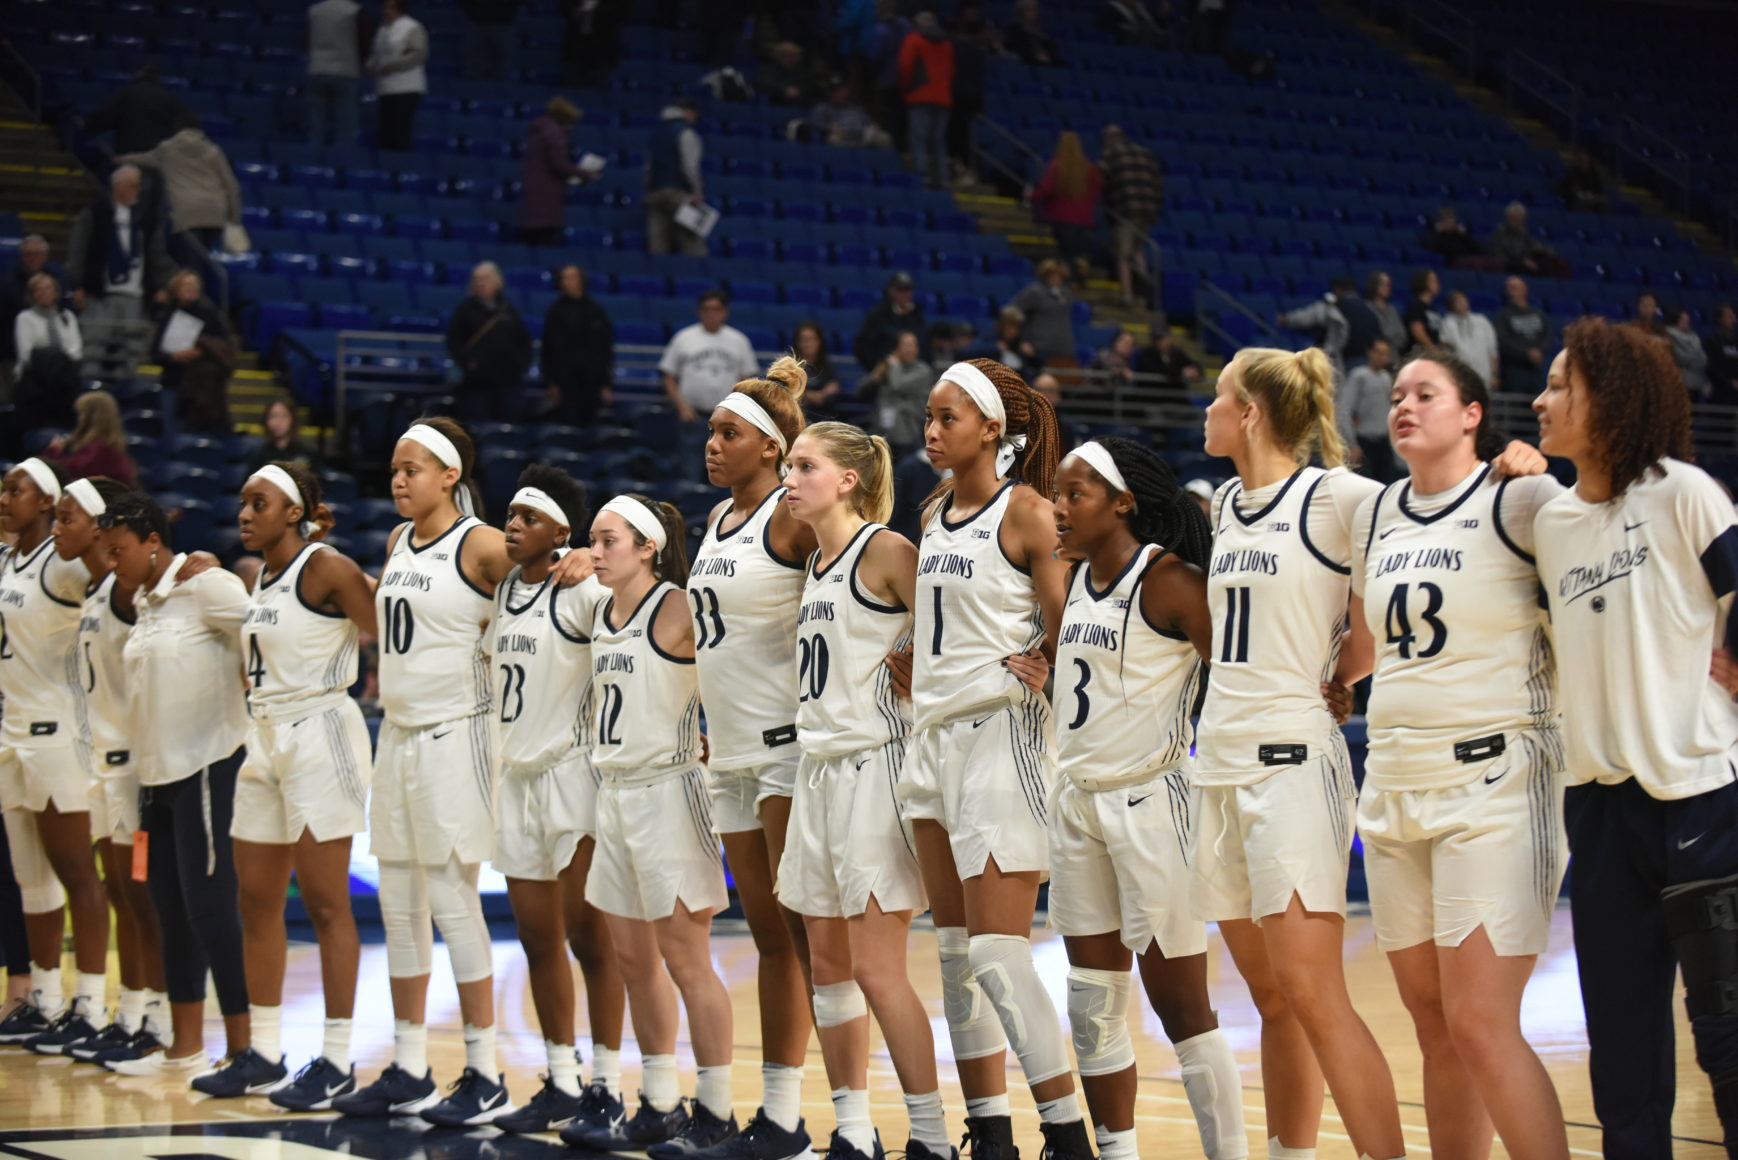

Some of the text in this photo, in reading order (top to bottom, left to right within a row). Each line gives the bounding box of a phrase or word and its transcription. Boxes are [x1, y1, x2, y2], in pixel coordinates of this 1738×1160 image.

[401, 571, 433, 592] LIONS
[691, 557, 737, 578] ADY LIONS
[917, 553, 975, 580] LADY LIONS
[1211, 550, 1279, 577] LADY LIONS
[1376, 548, 1463, 578] LADY LIONS
[384, 596, 415, 655] 10
[690, 586, 726, 652] 33
[798, 600, 835, 627] ADY LIONS
[932, 586, 944, 656] 1
[1059, 622, 1118, 652] LADY LIONS
[1220, 586, 1250, 663] 11
[1385, 581, 1448, 660] 43
[248, 633, 266, 688] 4
[511, 634, 537, 656] LIONS
[595, 653, 634, 676] LADY LIONS
[798, 633, 830, 703] 20
[500, 663, 526, 723] 23
[599, 683, 623, 745] 12
[1068, 657, 1091, 730] 3
